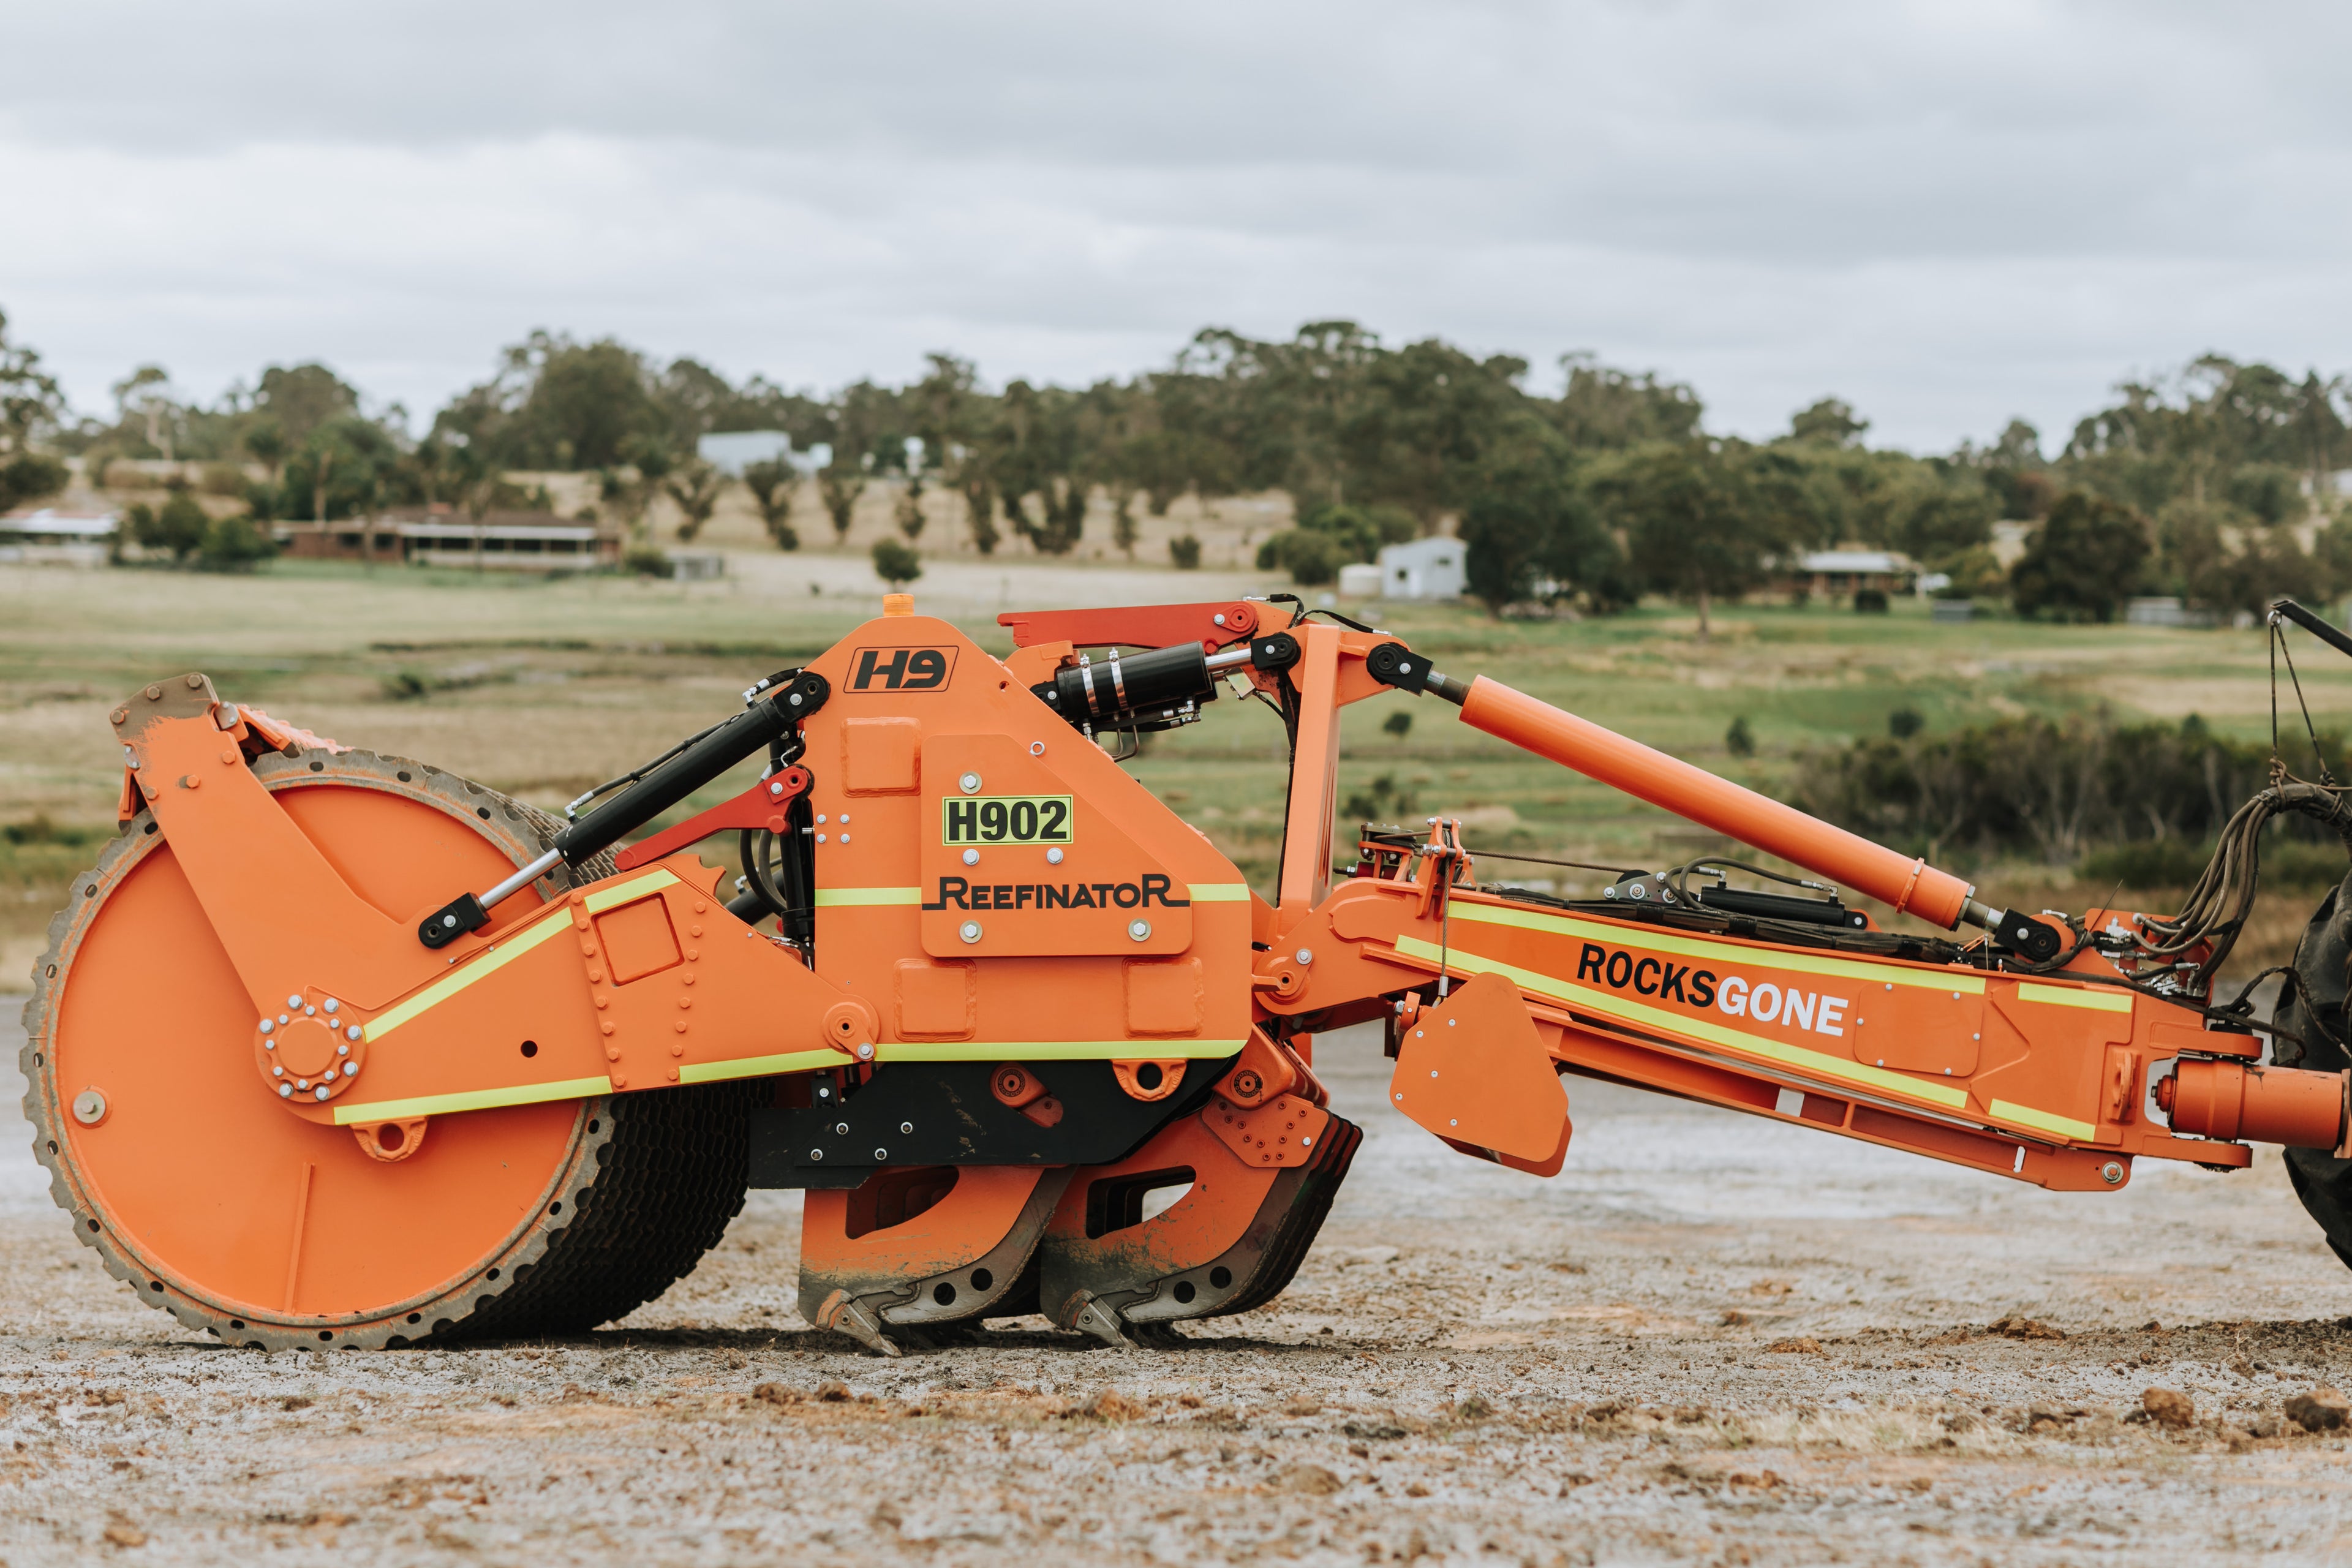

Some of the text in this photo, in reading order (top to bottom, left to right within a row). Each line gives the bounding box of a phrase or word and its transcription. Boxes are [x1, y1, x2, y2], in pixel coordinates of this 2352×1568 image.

[853, 649, 946, 690] H9
[948, 801, 1067, 841] H902
[1577, 943, 1849, 1037] ROCKSGONE
